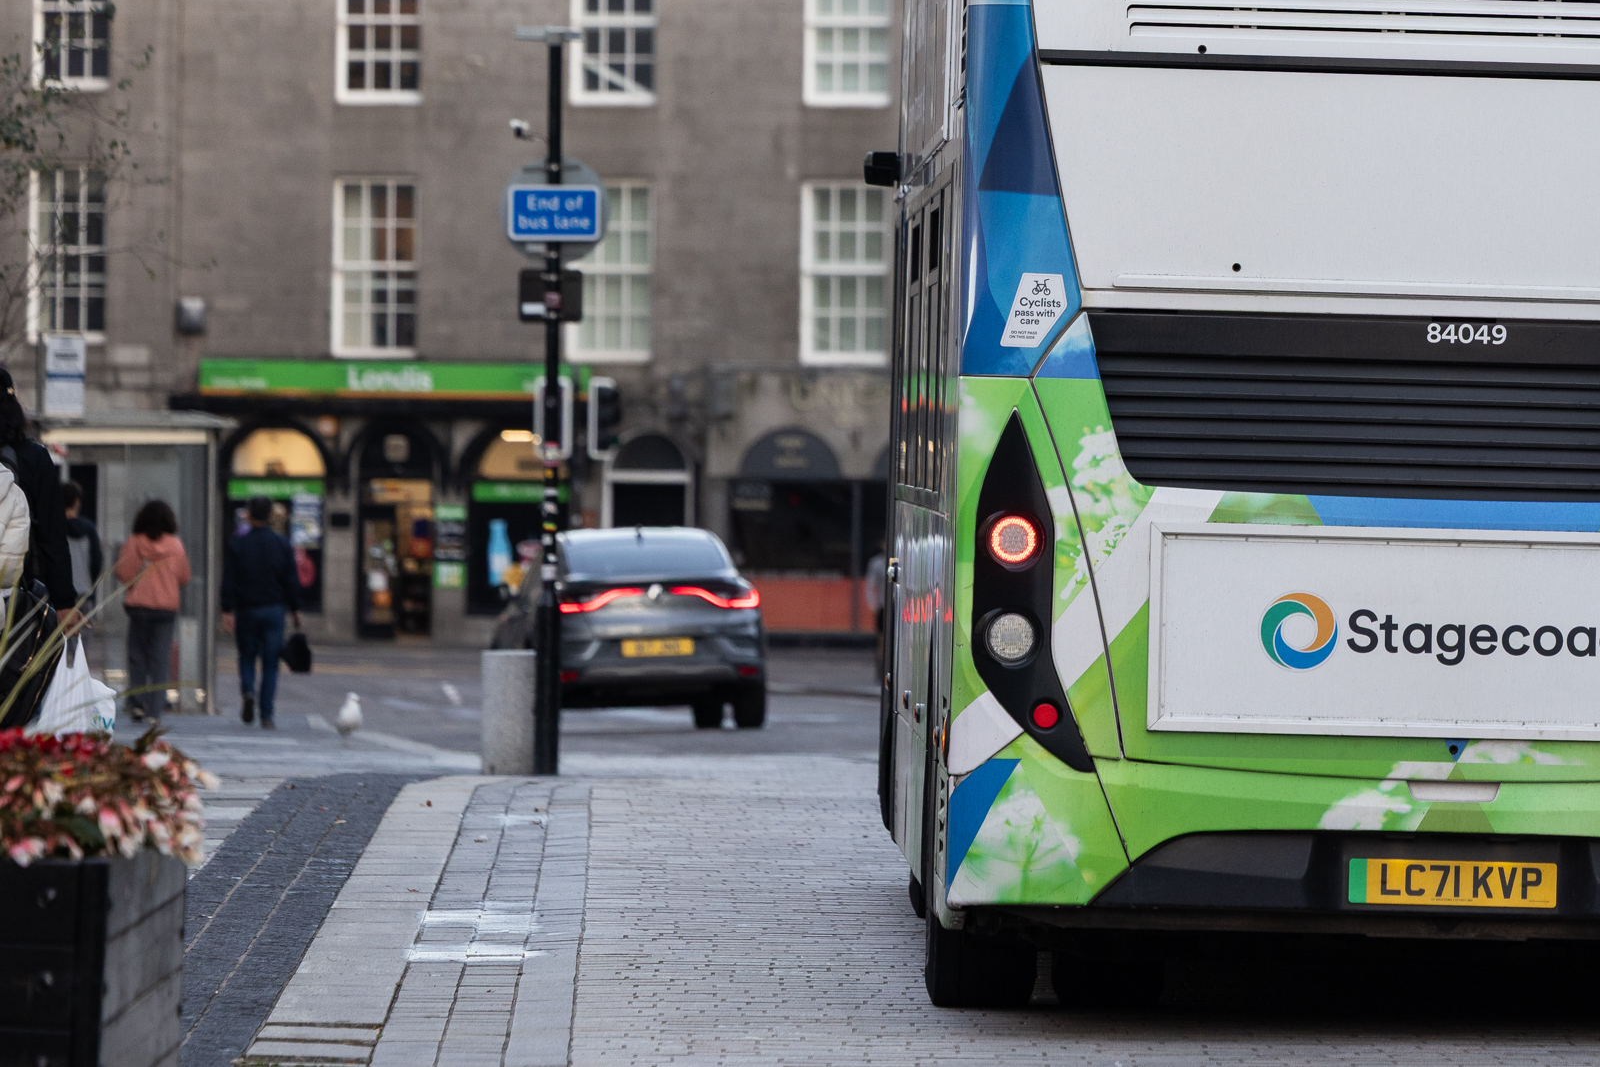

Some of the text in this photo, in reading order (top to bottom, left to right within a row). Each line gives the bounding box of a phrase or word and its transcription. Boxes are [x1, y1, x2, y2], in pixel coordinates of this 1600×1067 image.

[526, 194, 583, 211] End of
[518, 214, 590, 230] bus lane
[1019, 297, 1061, 308] Cyclists
[1014, 309, 1056, 318] pass with
[1426, 323, 1507, 345] 84049
[1380, 863, 1542, 900] LC71 KVP
